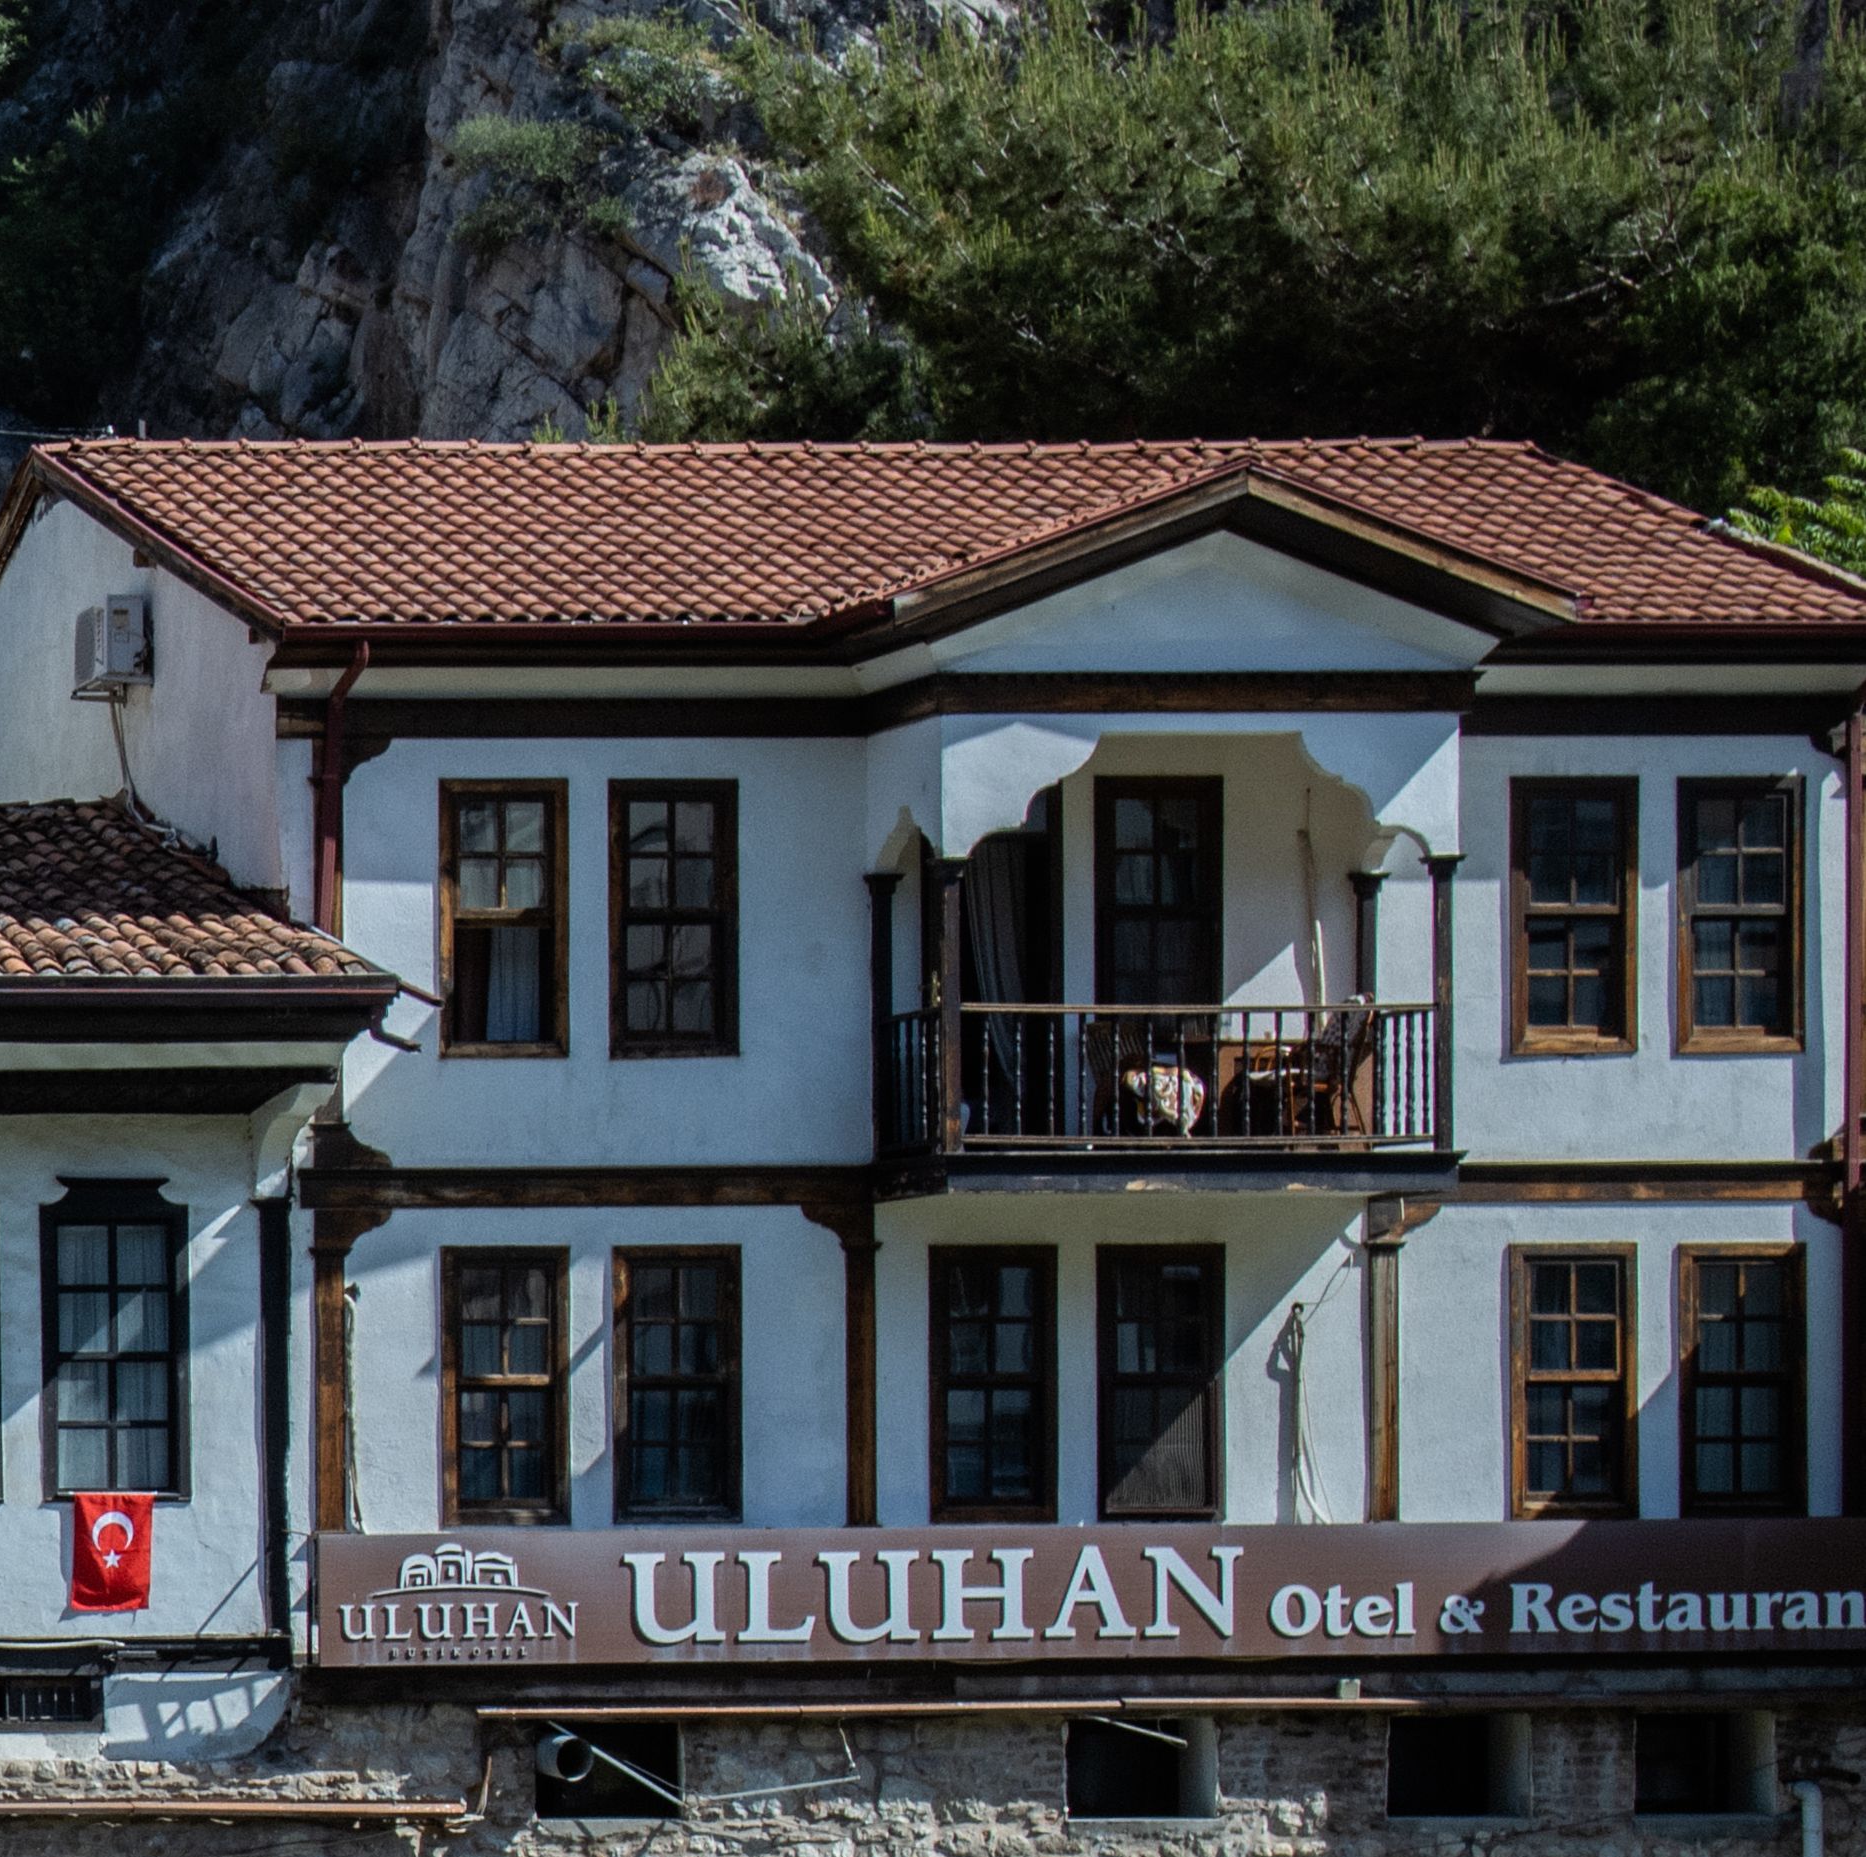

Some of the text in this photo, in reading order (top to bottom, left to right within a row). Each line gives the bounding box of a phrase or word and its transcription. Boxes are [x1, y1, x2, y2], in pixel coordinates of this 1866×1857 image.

[339, 1602, 579, 1640] ULUHAN
[610, 1545, 1244, 1644] ULUHAN
[1269, 1582, 1417, 1637] Otel
[1440, 1595, 1485, 1633] &
